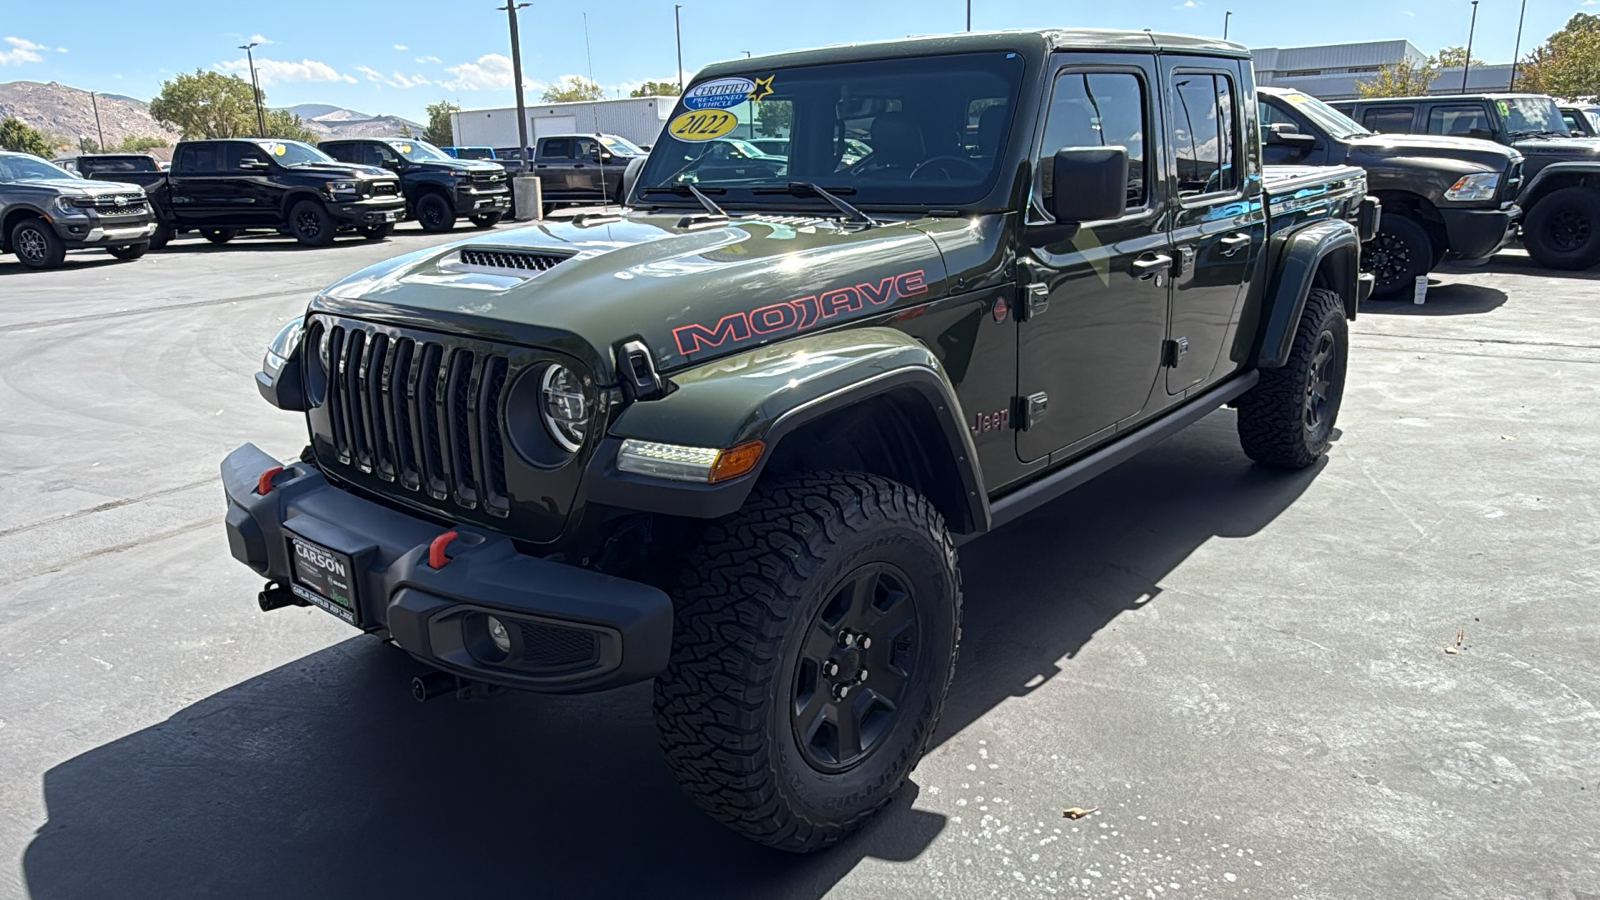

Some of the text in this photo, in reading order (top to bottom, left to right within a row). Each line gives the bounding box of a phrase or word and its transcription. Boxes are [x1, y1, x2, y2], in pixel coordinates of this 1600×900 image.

[693, 82, 750, 97] CERTIFIED
[692, 94, 743, 104] PRE-OWNED
[698, 100, 733, 108] VEHICLE
[1496, 101, 1509, 117] 13
[675, 114, 729, 134] 2022
[672, 269, 928, 355] MOJAVE
[971, 408, 1008, 435] Jeep
[295, 543, 346, 578] CARSON
